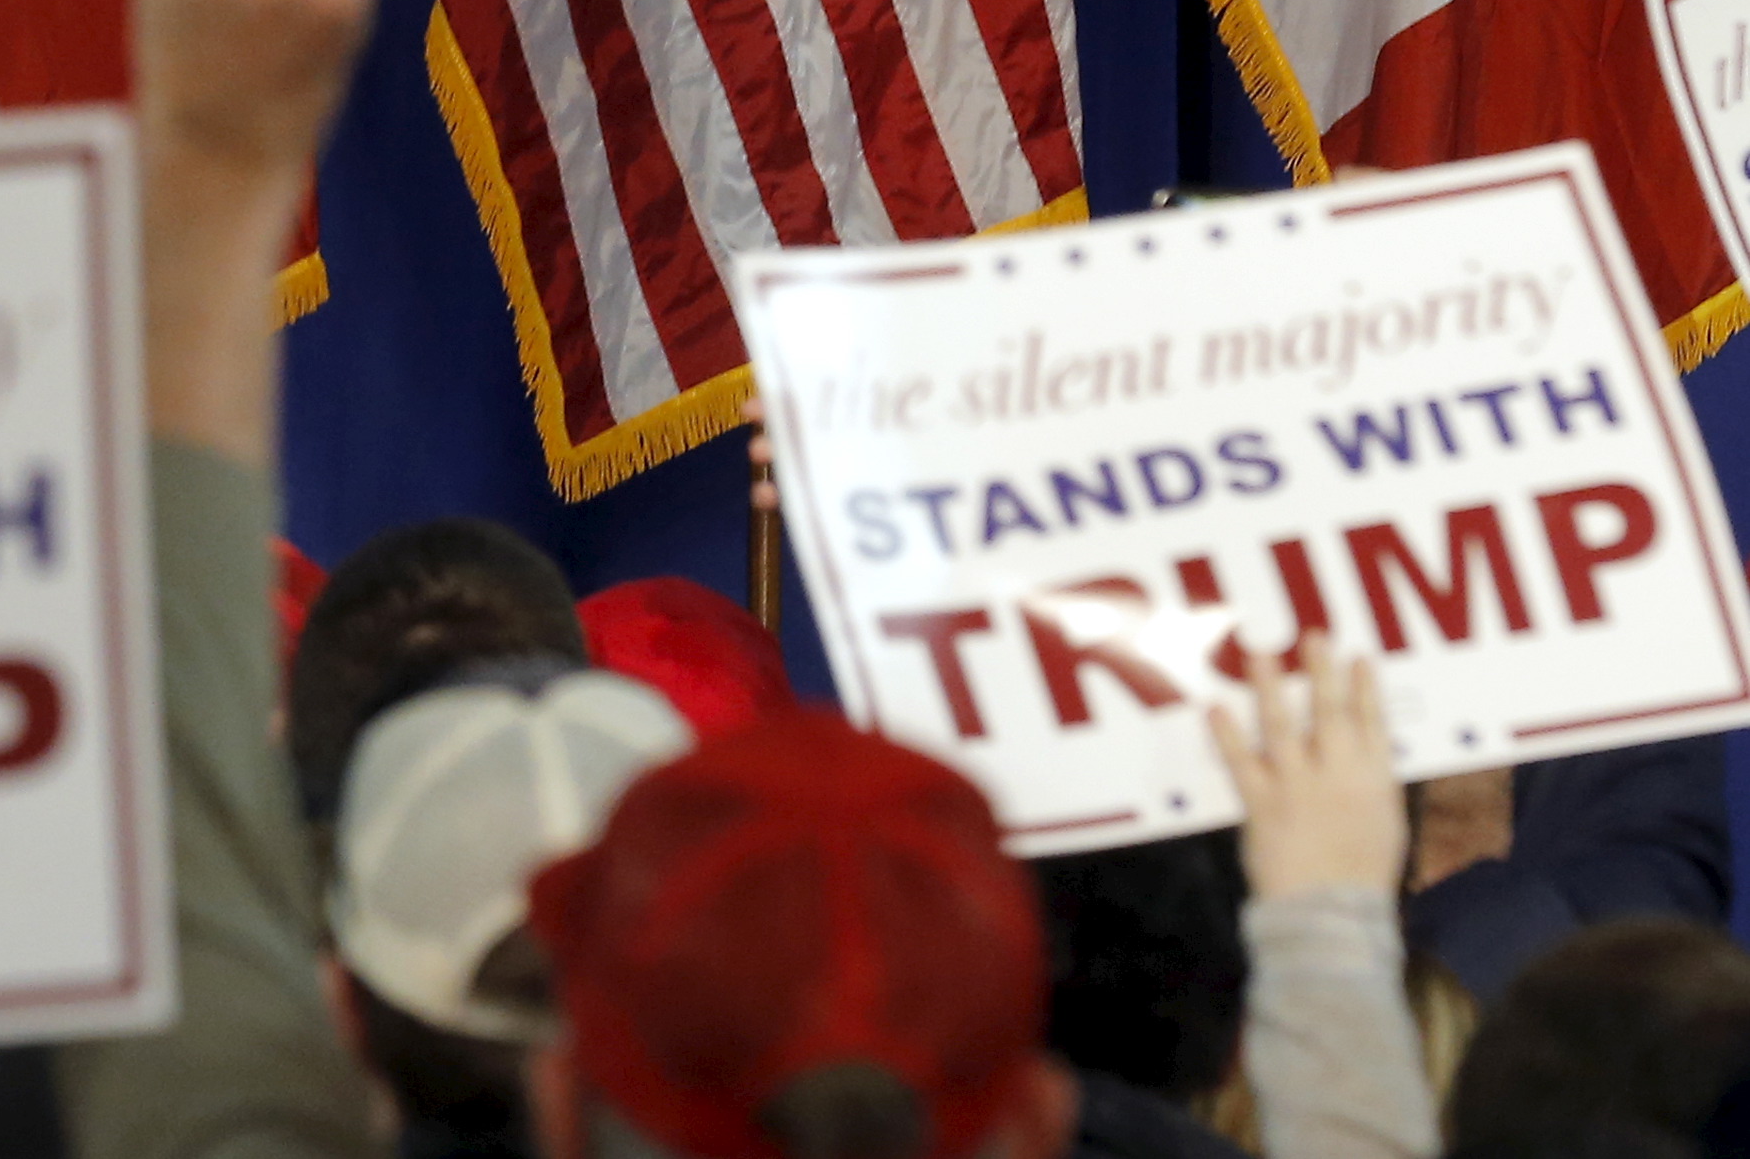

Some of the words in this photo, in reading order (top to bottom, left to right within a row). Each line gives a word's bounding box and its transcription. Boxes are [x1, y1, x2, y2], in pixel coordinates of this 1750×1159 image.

[947, 313, 1180, 427] silent
[1196, 257, 1570, 397] majority
[844, 427, 1288, 565] STANDS
[1314, 365, 1626, 475] WITH
[877, 479, 1664, 743] TRUMP
